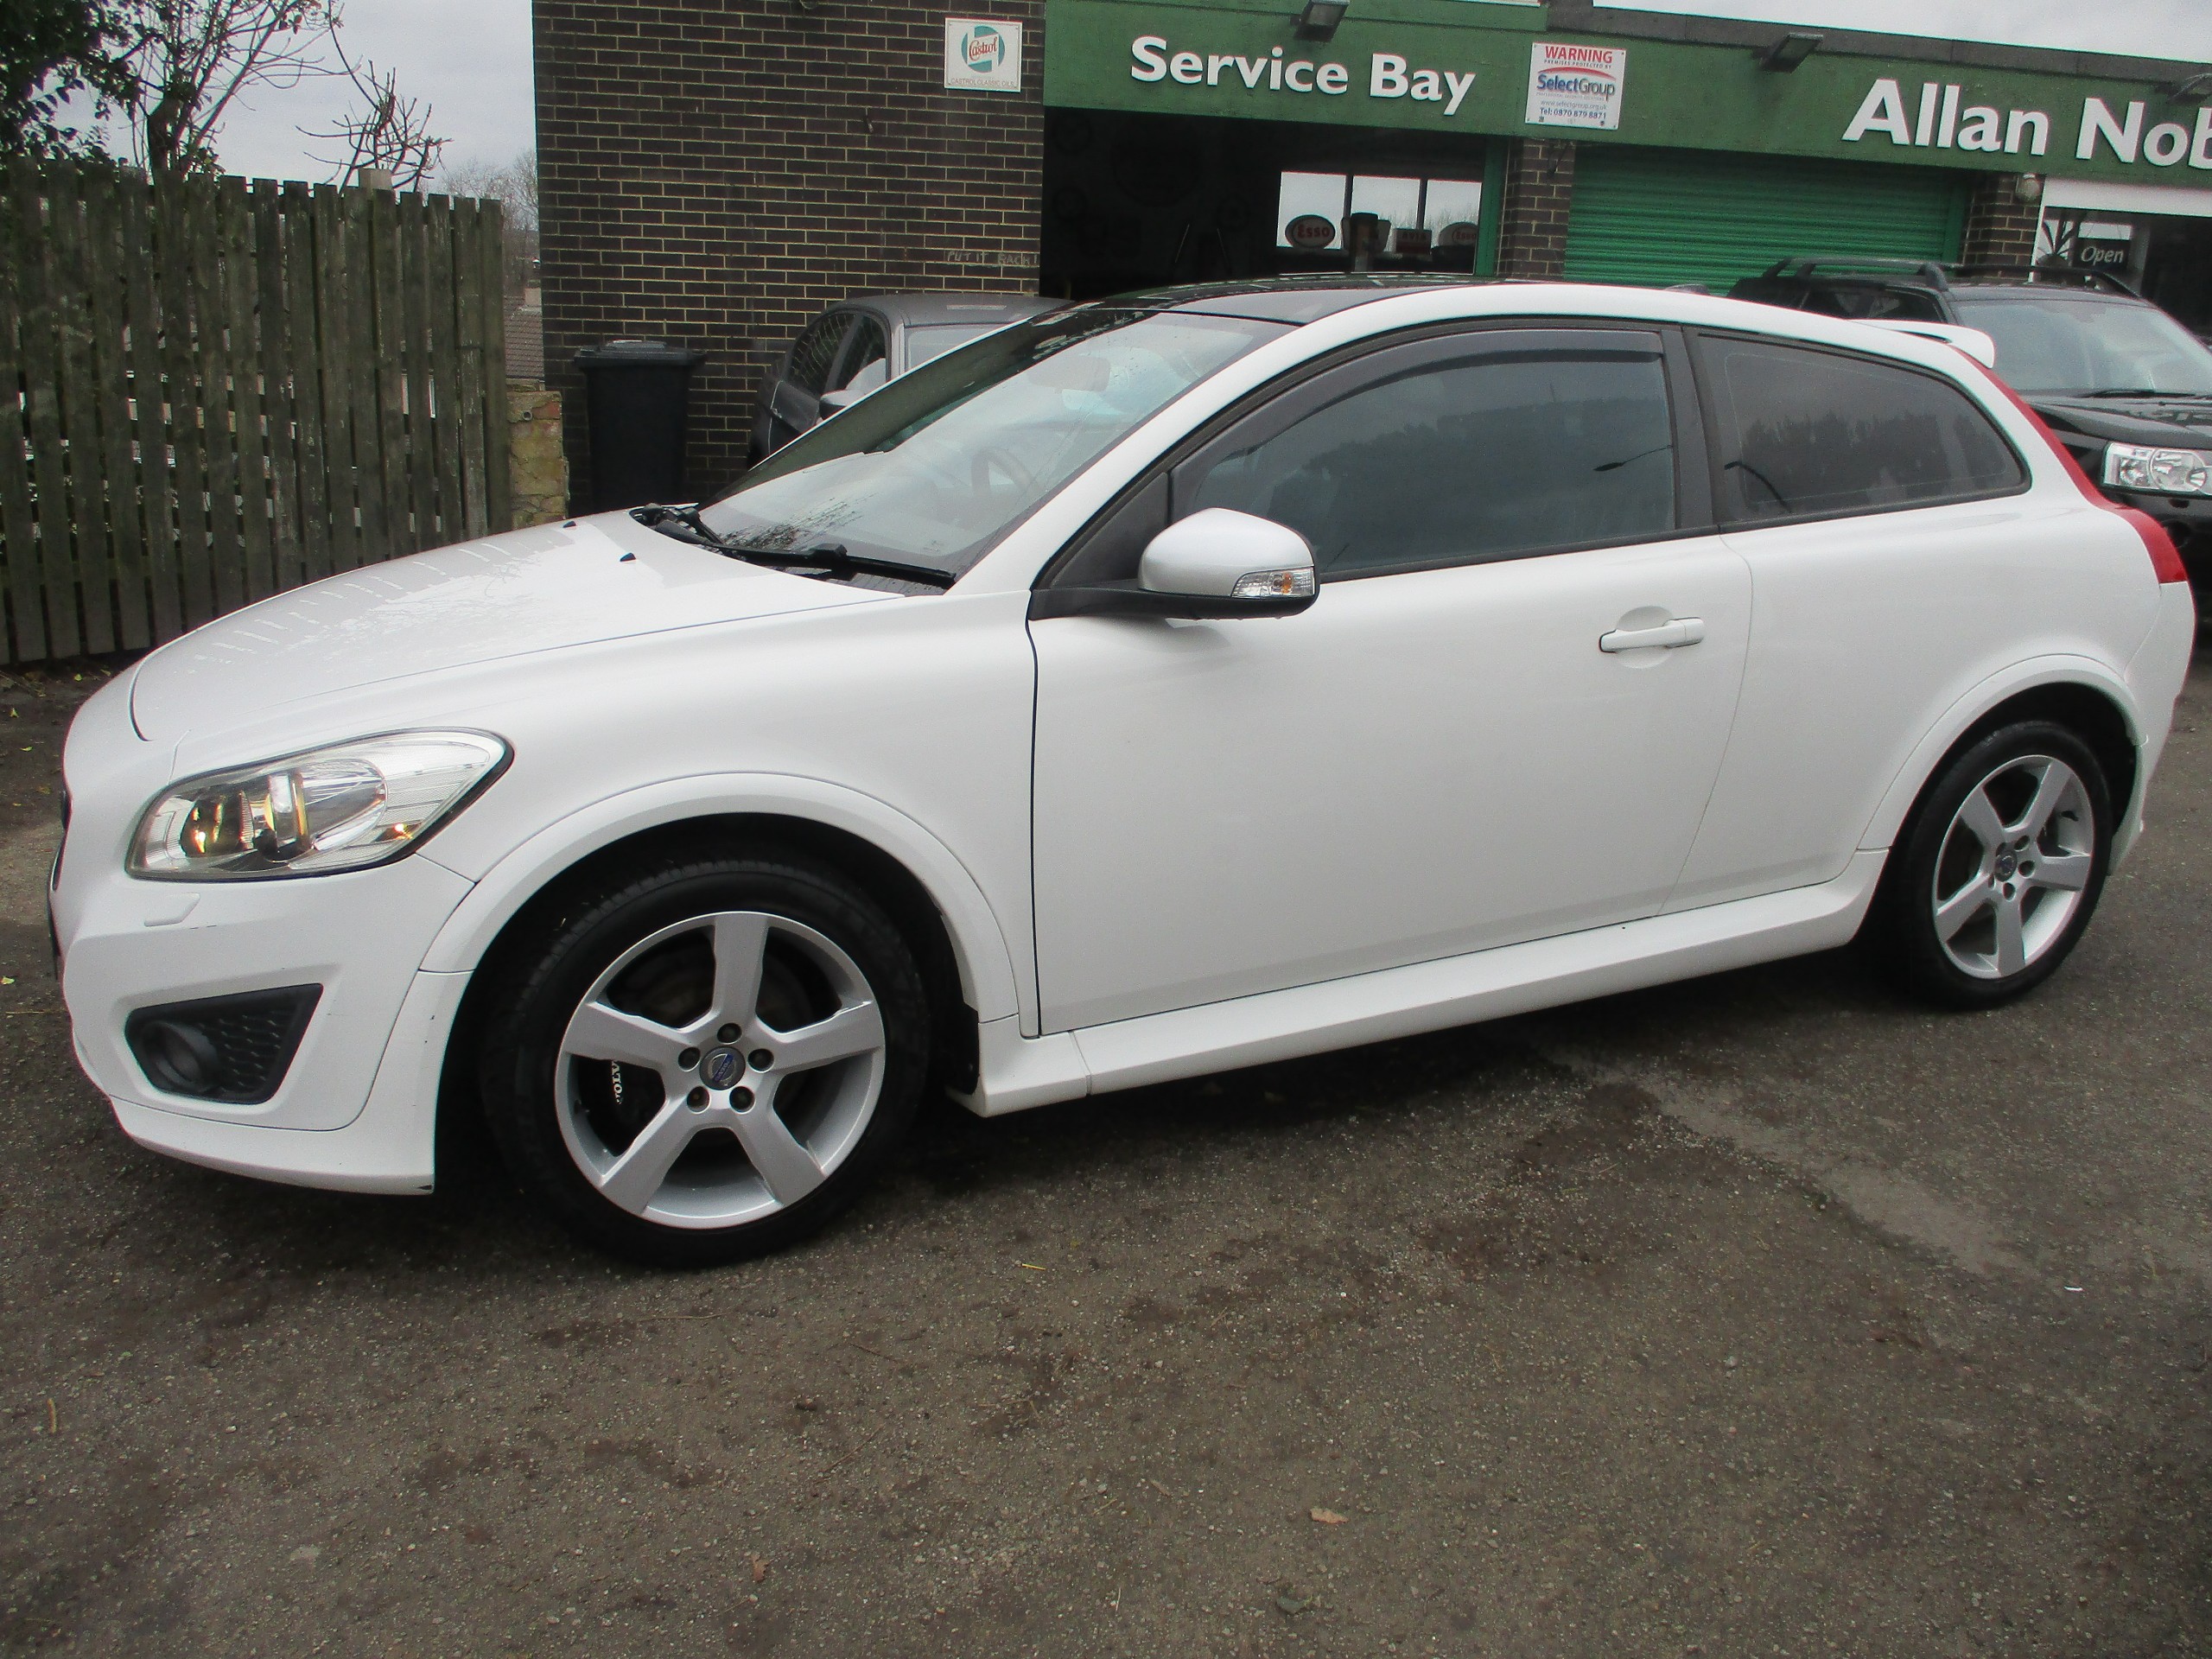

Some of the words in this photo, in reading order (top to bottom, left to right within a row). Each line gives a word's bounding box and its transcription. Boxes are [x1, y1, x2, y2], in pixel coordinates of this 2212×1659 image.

[969, 36, 998, 61] Castrol
[1545, 46, 1613, 63] WARNING
[1130, 35, 1348, 94] Service
[1370, 53, 1476, 116] Bay
[1536, 73, 1615, 101] SelectGroup
[1554, 108, 1572, 117] 0870
[1588, 111, 1606, 119] 8871
[1841, 78, 2050, 156] Allan
[2081, 245, 2124, 265] Open
